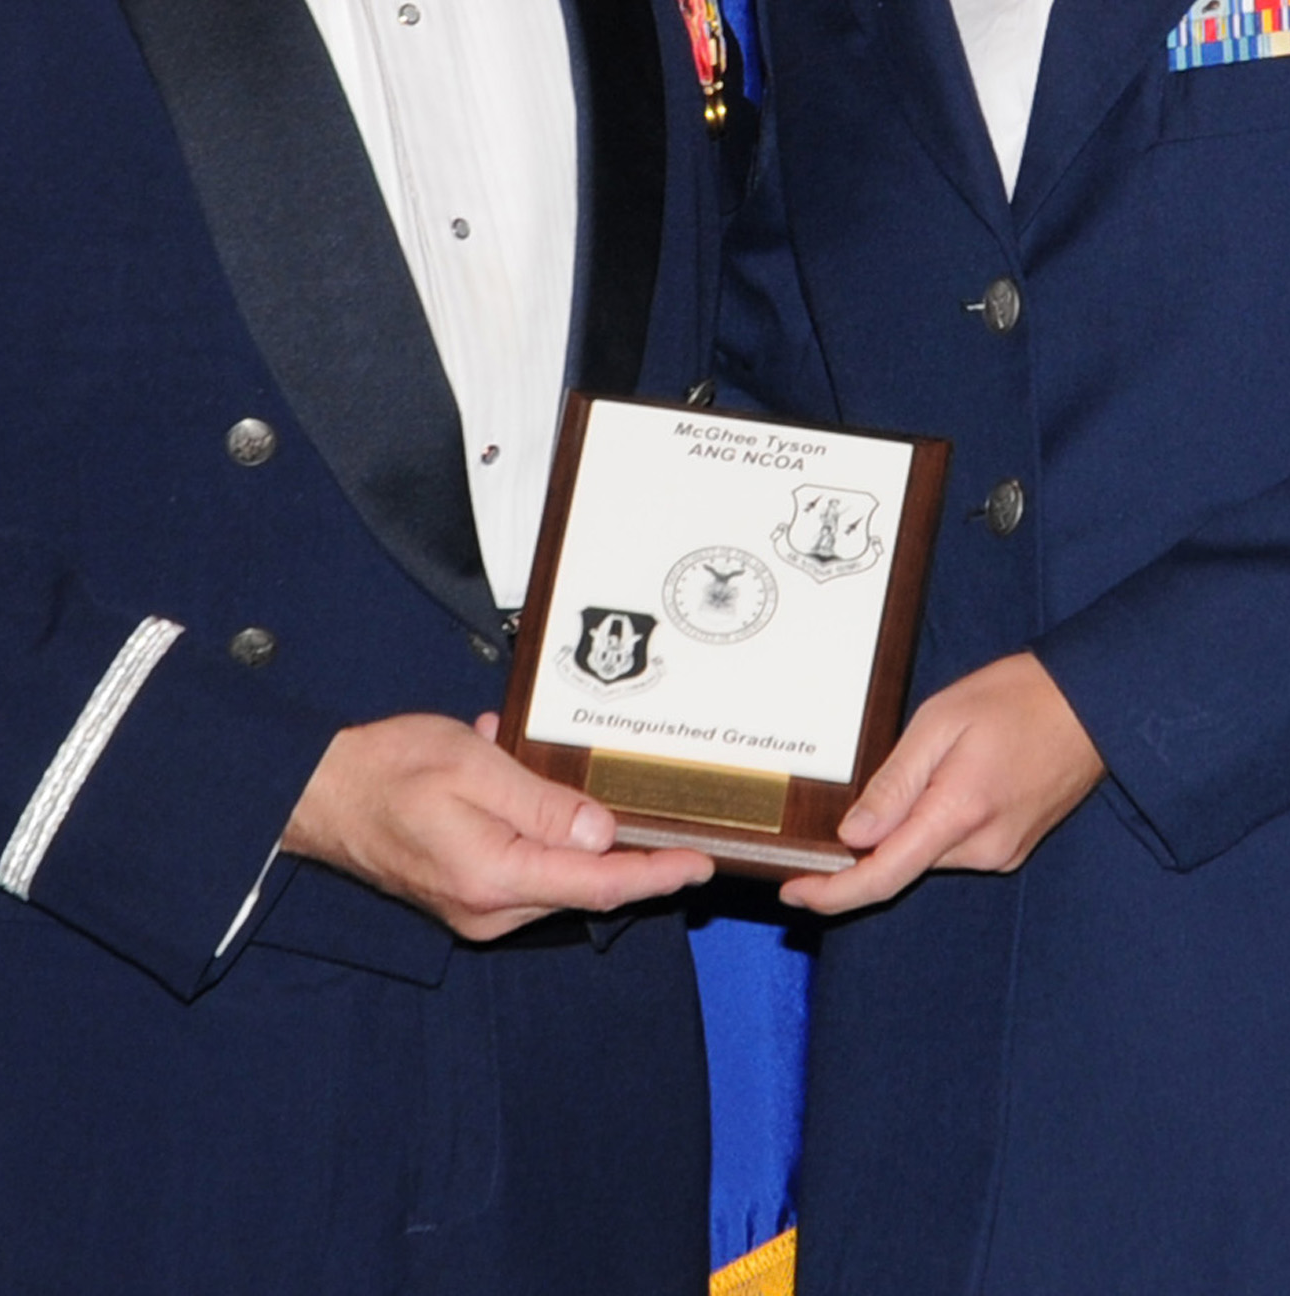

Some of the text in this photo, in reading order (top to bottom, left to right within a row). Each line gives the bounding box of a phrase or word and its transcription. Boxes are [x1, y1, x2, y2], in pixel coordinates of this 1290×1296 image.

[674, 422, 827, 456] McGhee Tyson
[688, 443, 805, 472] ANG NCOA
[572, 708, 817, 755] Distinguished Graduate
